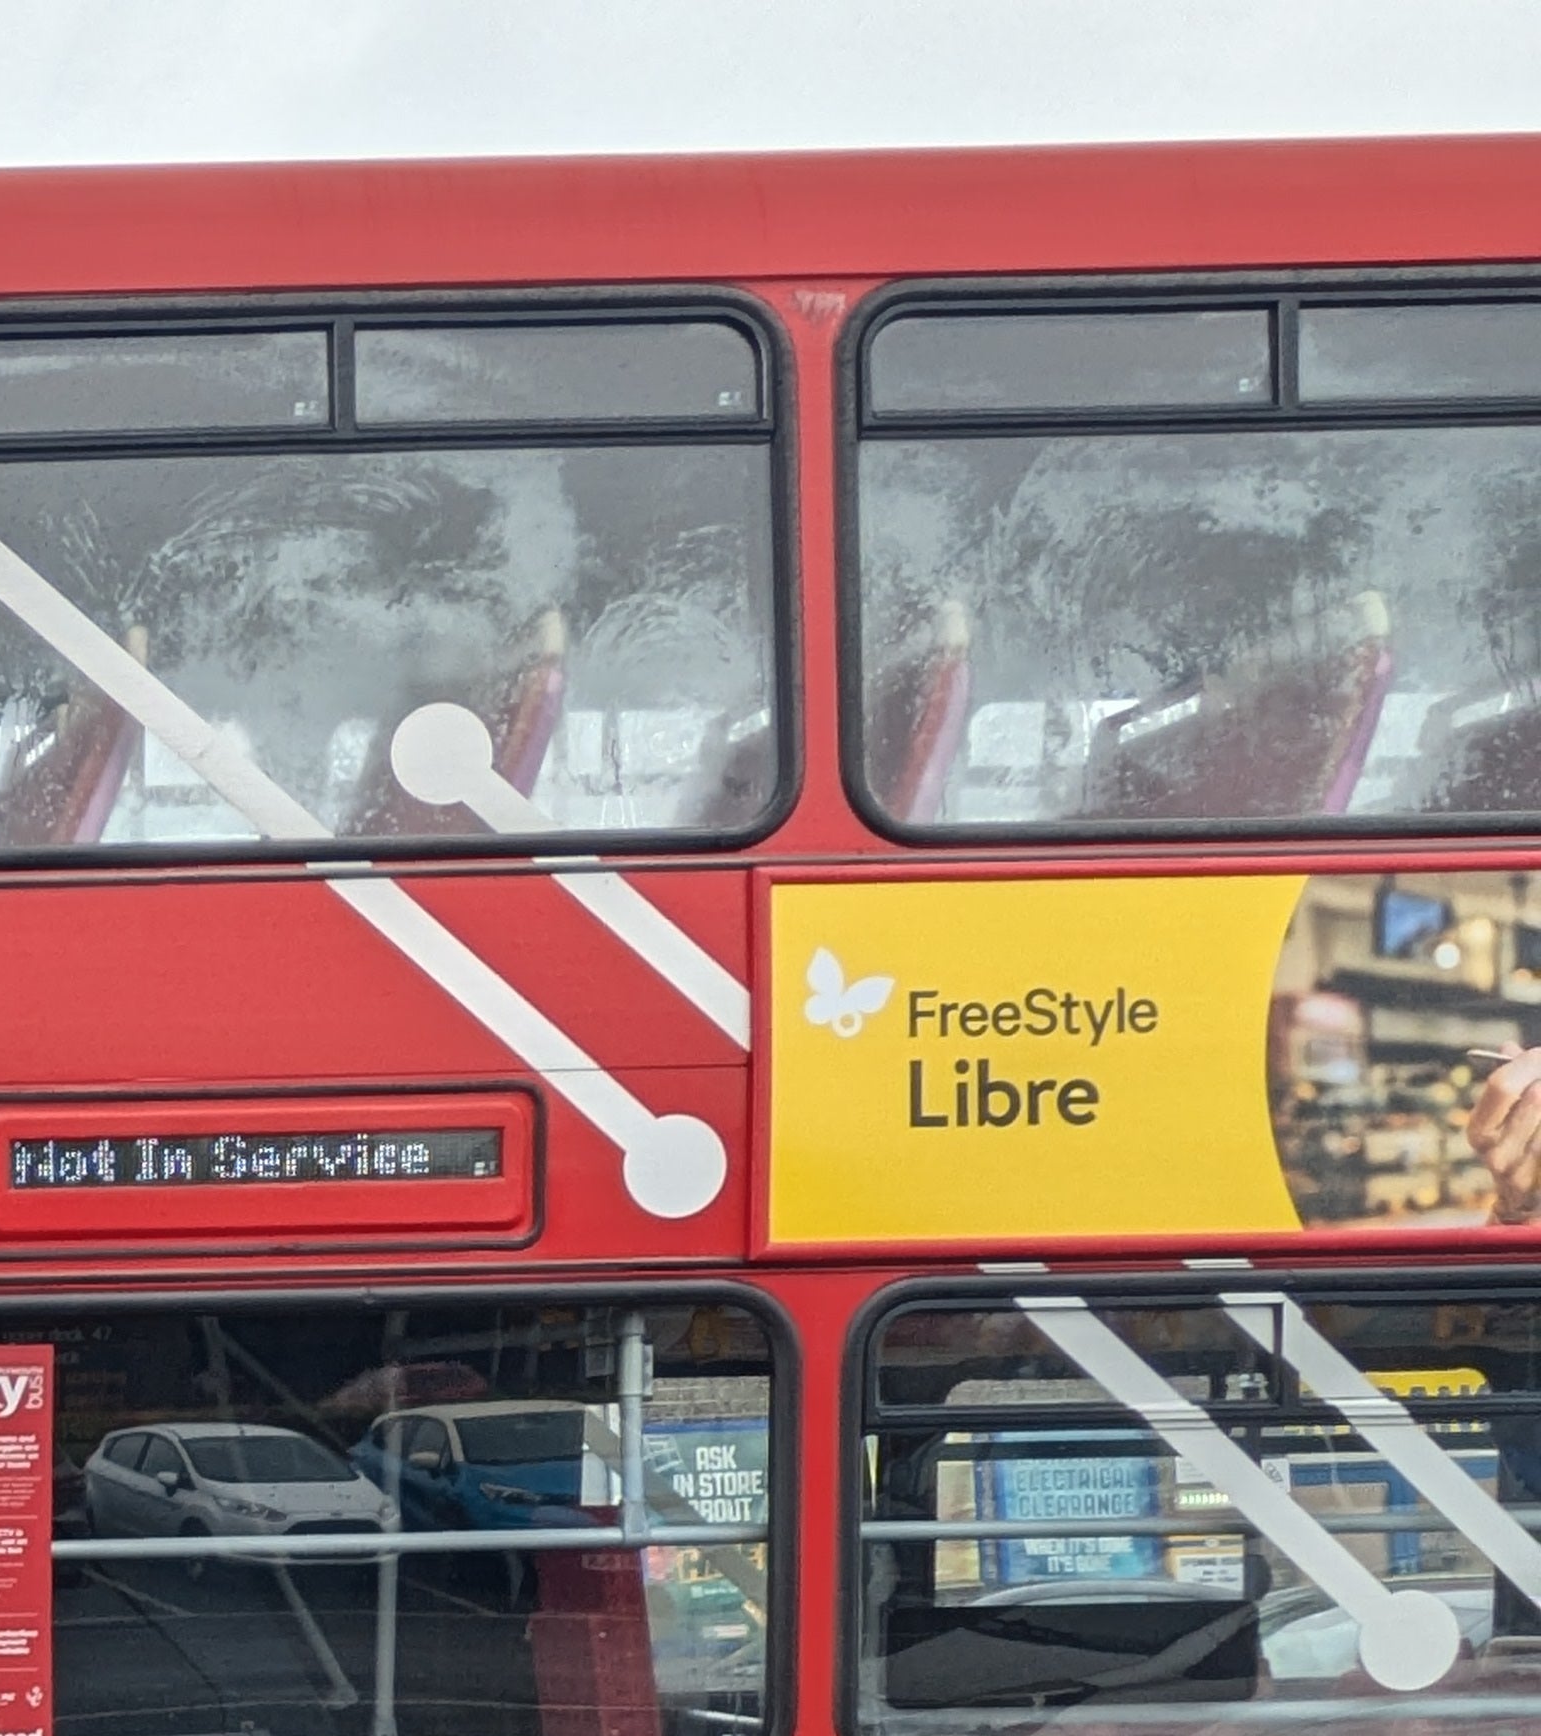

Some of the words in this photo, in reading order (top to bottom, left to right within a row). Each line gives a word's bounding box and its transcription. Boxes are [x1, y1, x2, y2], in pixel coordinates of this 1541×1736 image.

[908, 987, 1158, 1046] FreeStyle
[909, 1058, 1100, 1129] Libre
[25, 1375, 44, 1409] bus
[695, 1445, 737, 1471] ASK
[673, 1473, 694, 1498] IN
[699, 1470, 764, 1497] STORE
[1018, 1467, 1136, 1491] ELECTRICAL
[1019, 1492, 1134, 1517] CLEARANCE
